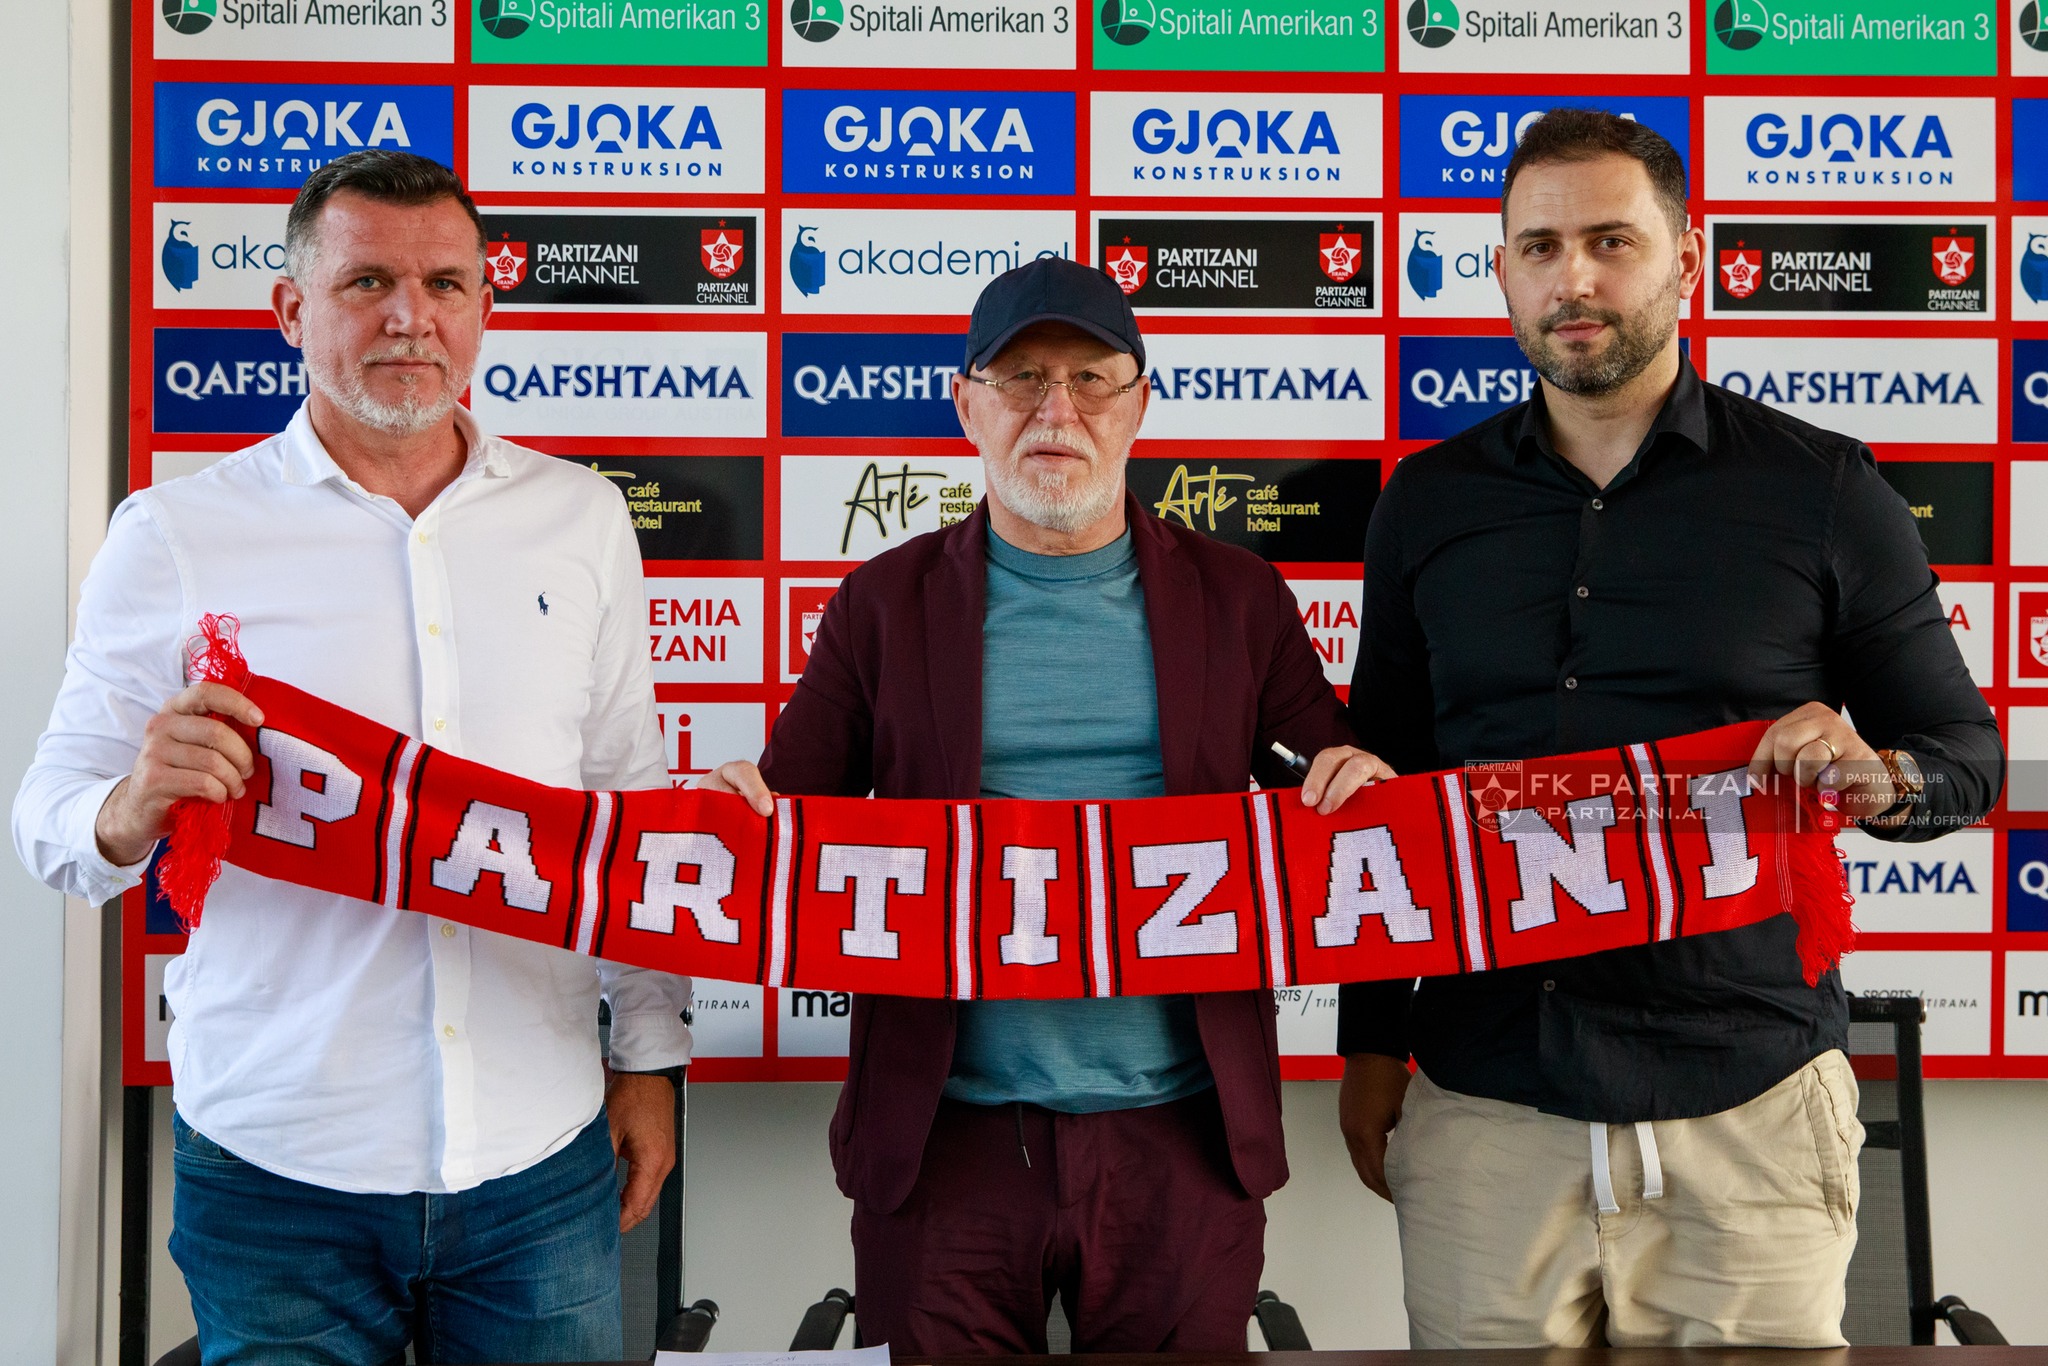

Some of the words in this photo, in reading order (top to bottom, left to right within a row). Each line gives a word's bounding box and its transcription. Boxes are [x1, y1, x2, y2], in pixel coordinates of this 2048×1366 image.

[223, 0, 297, 30] Spitali
[304, 0, 422, 26] Amerikan
[431, 0, 447, 27] 3
[539, 0, 613, 34] Spitali
[619, 2, 736, 30] Amerikan
[745, 2, 761, 31] 3
[850, 4, 923, 37] Spitali
[929, 5, 1044, 33] Amerikan
[1053, 6, 1069, 34] 3
[1159, 8, 1232, 40] Spitali
[1238, 8, 1353, 36] Amerikan
[1362, 9, 1378, 37] 3
[1465, 10, 1537, 43] Spitali
[1544, 11, 1658, 38] Amerikan
[1667, 11, 1682, 39] 3
[1772, 12, 1844, 45] Spitali
[1851, 13, 1965, 40] Amerikan
[1974, 13, 1989, 41] 3
[197, 98, 411, 150] GJOKA
[511, 103, 723, 153] GJOKA
[824, 105, 1034, 156] GJOKA
[1132, 108, 1341, 158] GJOKA
[1746, 113, 1953, 162] GJOKA
[197, 157, 327, 172] KONSTRU
[512, 161, 723, 176] KONSTRUKSION
[825, 163, 1034, 179] KONSTRUKSION
[1133, 166, 1341, 182] KONSTRUKSION
[1747, 169, 1953, 185] KONSTRUKSION
[536, 243, 639, 263] PARTIZANI
[1157, 248, 1258, 267] PARTIZANI
[1770, 252, 1871, 271] PARTIZANI
[535, 265, 640, 285] CHANNEL
[1156, 269, 1259, 288] CHANNEL
[1769, 272, 1872, 292] CHANNEL
[697, 282, 749, 293] PARTIZANI
[1315, 286, 1367, 297] PARTIZANI
[1928, 289, 1980, 300] PARTIZANI
[696, 293, 750, 304] CHANNEL
[1314, 296, 1367, 307] CHANNEL
[1927, 300, 1980, 311] CHANNEL
[166, 360, 308, 401] QAFSH
[484, 362, 754, 403] QAFSHTAMA
[793, 365, 960, 405] QAFSHT
[1150, 366, 1373, 401] AFSHTAMA
[627, 481, 661, 498] café
[940, 482, 973, 499] café
[1246, 485, 1279, 501] café
[628, 499, 703, 513] restaurant
[840, 462, 949, 555] Arté
[1246, 502, 1321, 516] restaurant
[1246, 517, 1281, 532] hôtel
[253, 727, 1761, 967] PARTIZANI
[697, 999, 751, 1010] TIRANA
[1926, 999, 1978, 1008] TIRANA
